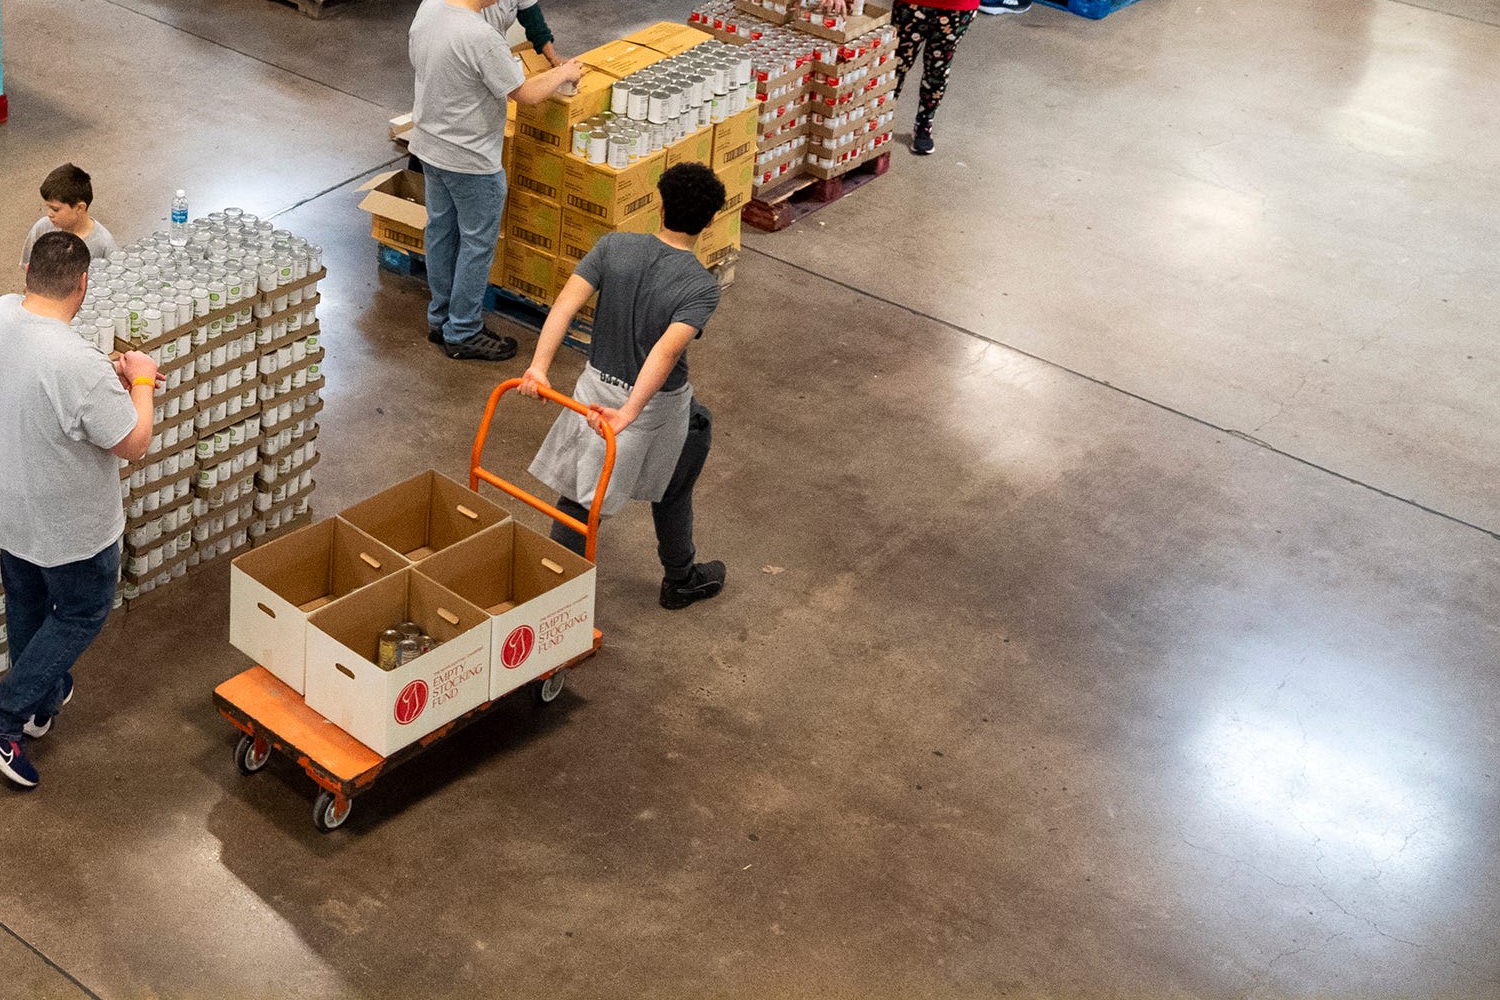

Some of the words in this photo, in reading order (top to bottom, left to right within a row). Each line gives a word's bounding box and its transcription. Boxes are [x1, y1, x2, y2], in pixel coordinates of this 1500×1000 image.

[539, 609, 571, 633] EMPTY
[539, 611, 588, 643] STOCKING
[539, 634, 564, 655] FUND
[433, 661, 466, 687] EMPTY
[433, 663, 483, 698] STOCKING
[432, 687, 459, 709] FUND
